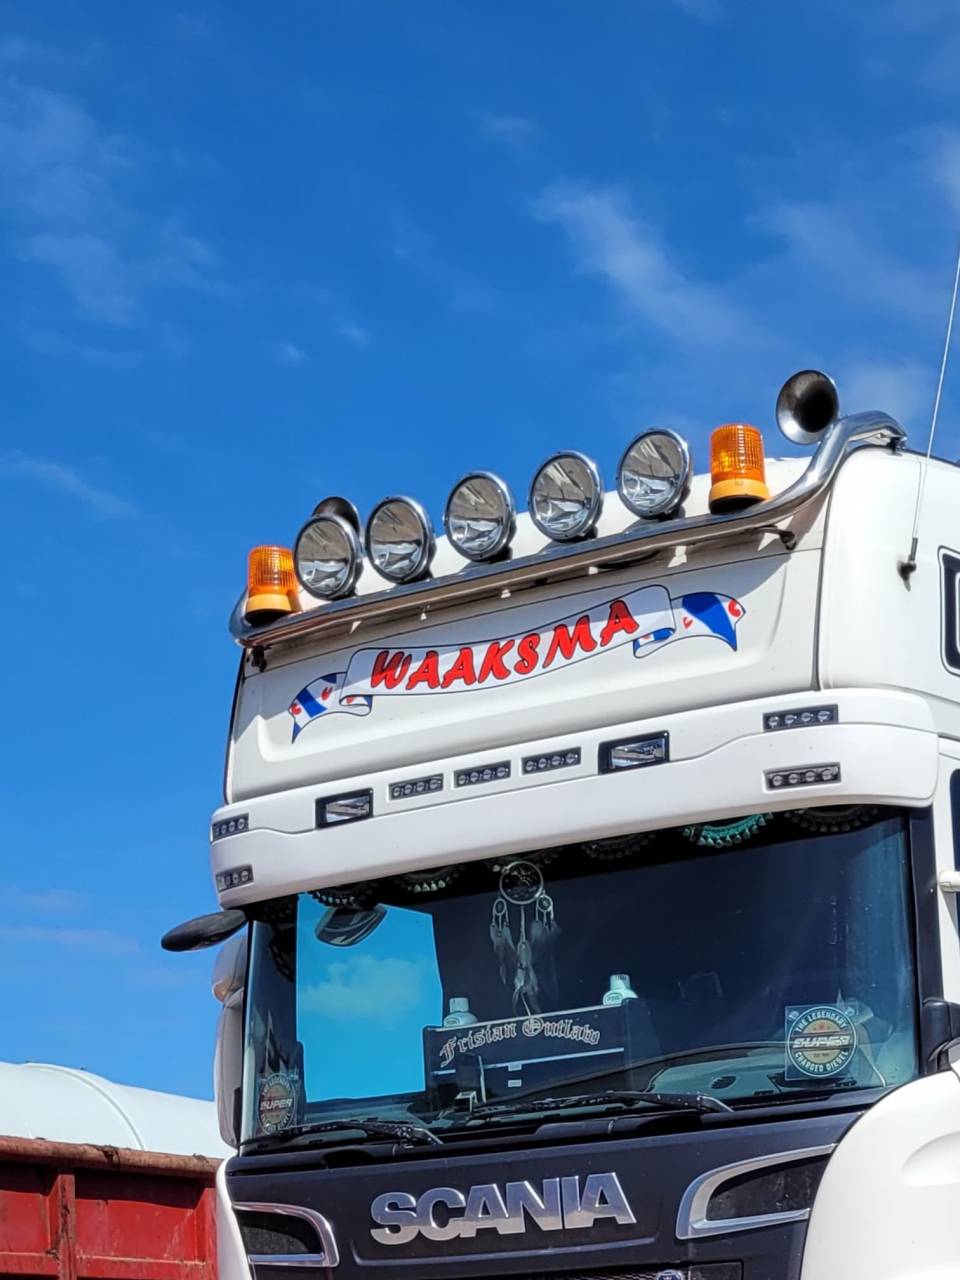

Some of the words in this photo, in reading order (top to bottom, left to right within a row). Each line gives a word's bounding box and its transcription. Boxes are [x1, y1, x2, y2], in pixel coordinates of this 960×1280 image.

[368, 598, 641, 691] WAAKSMA
[439, 1021, 518, 1069] Frisian
[521, 1015, 601, 1047] Outlaw
[792, 1034, 851, 1049] SUPER
[369, 1171, 638, 1246] SCANIA
